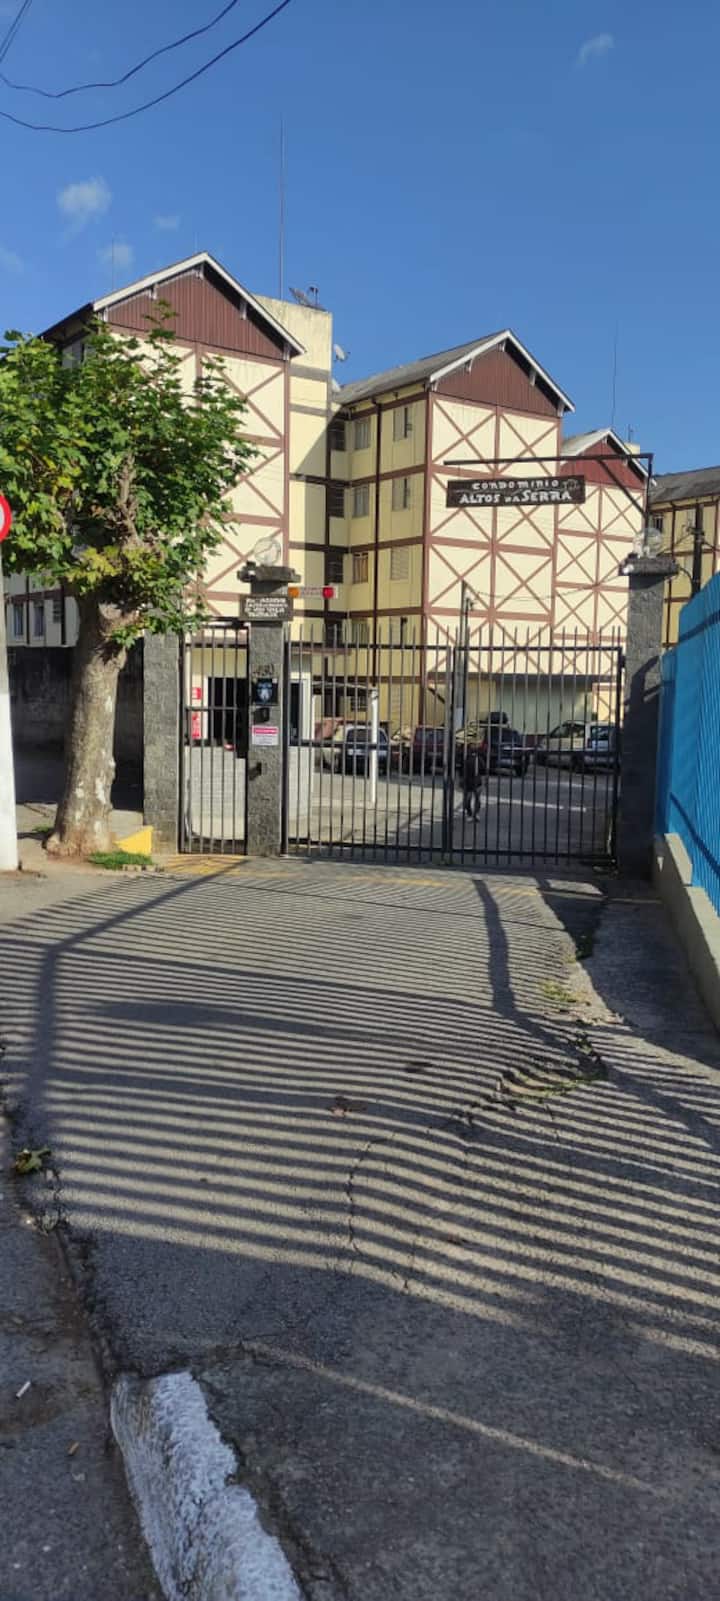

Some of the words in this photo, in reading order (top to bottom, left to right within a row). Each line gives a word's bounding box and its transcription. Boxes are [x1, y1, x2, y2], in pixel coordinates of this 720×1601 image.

[472, 480, 559, 490] CONDOMINIO
[459, 493, 501, 504] ALTOS
[521, 490, 572, 503] SERRA
